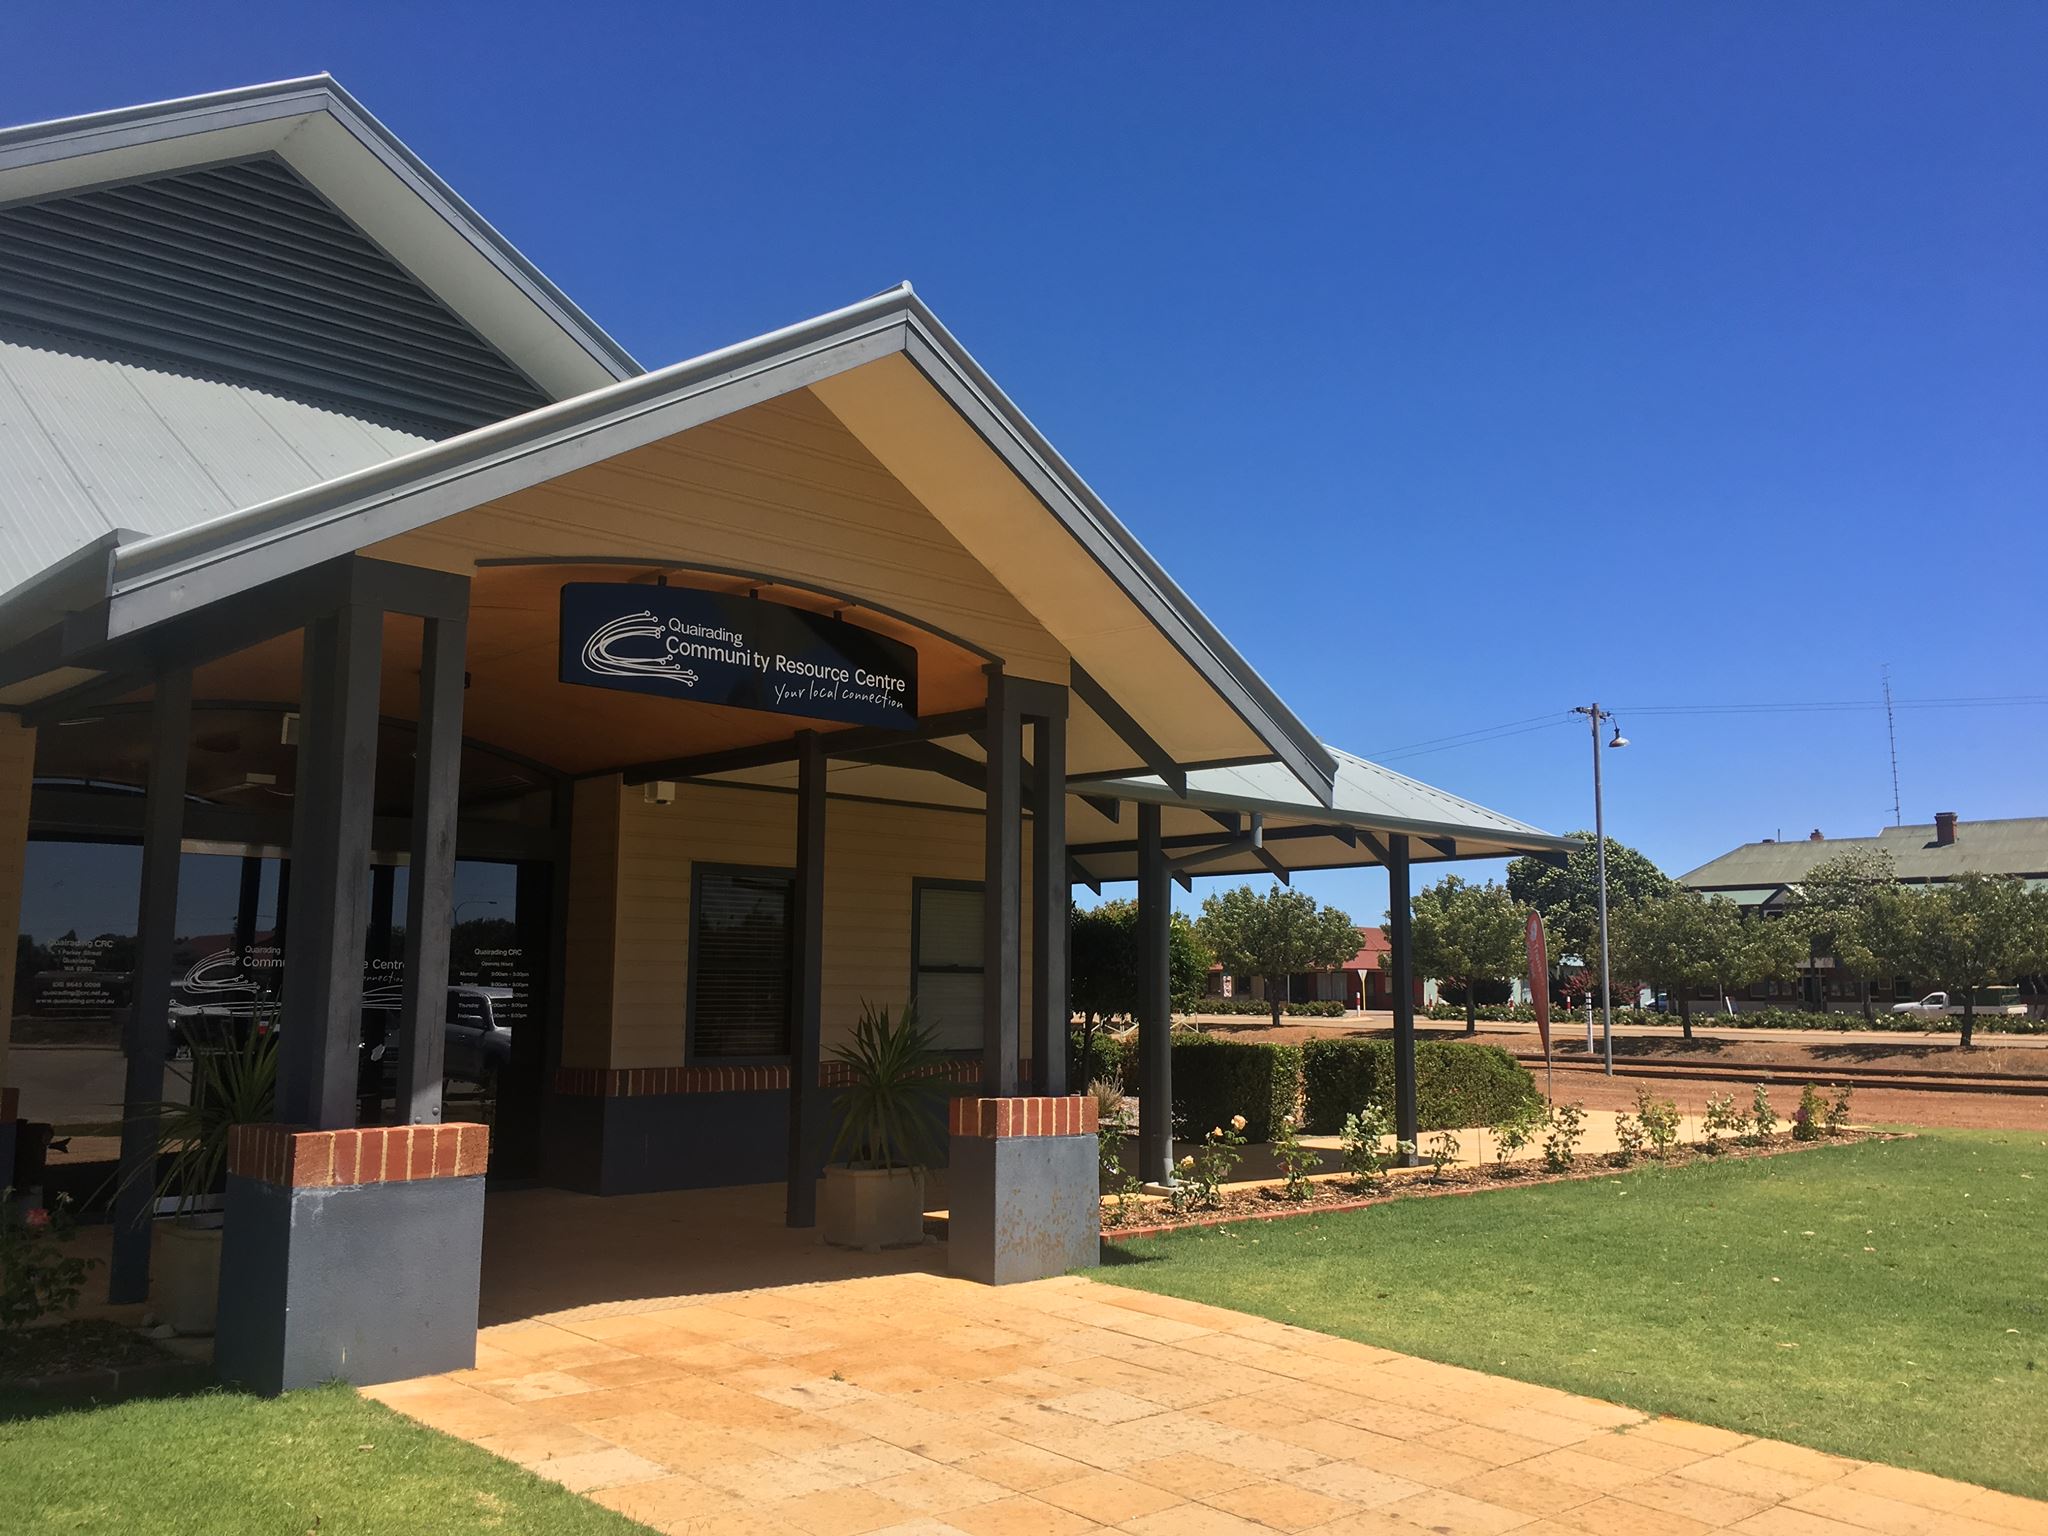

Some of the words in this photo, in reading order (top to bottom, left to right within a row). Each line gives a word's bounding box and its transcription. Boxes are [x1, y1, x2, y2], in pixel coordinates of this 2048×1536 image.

[668, 617, 744, 648] Quairading
[665, 636, 771, 673] Community
[776, 654, 849, 683] Resource
[855, 669, 906, 693] Centre
[775, 683, 805, 705] Your
[810, 680, 839, 702] local
[842, 688, 904, 710] connection
[94, 940, 114, 948] CRC
[245, 945, 281, 956] Quairading
